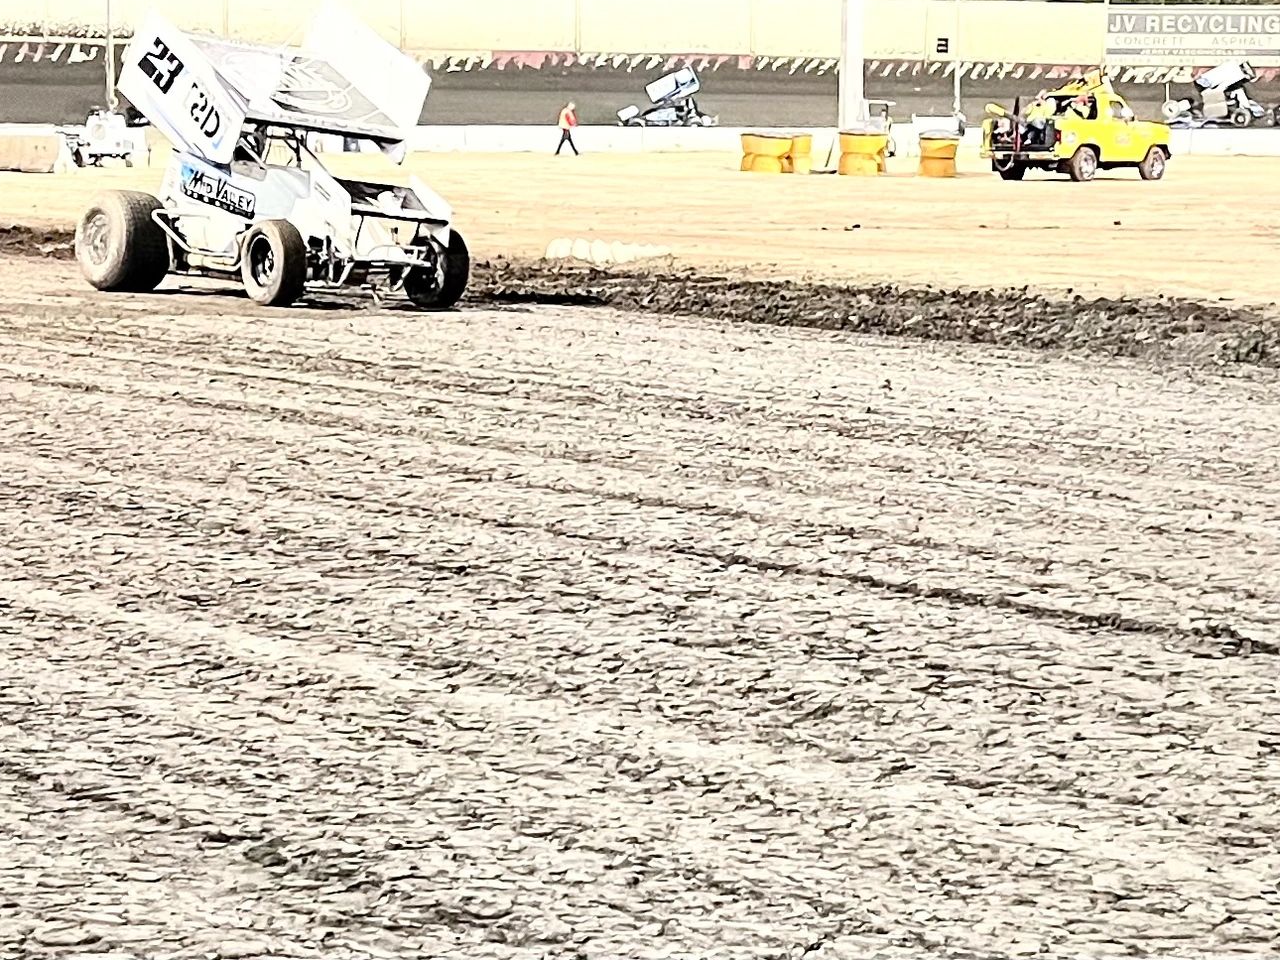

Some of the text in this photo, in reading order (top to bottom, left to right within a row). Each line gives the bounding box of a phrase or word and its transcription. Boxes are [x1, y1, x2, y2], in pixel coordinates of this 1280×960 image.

[1109, 14, 1280, 33] JV RECYCLING
[1114, 36, 1273, 47] CONCRETE ASPHALT
[138, 36, 184, 94] 23
